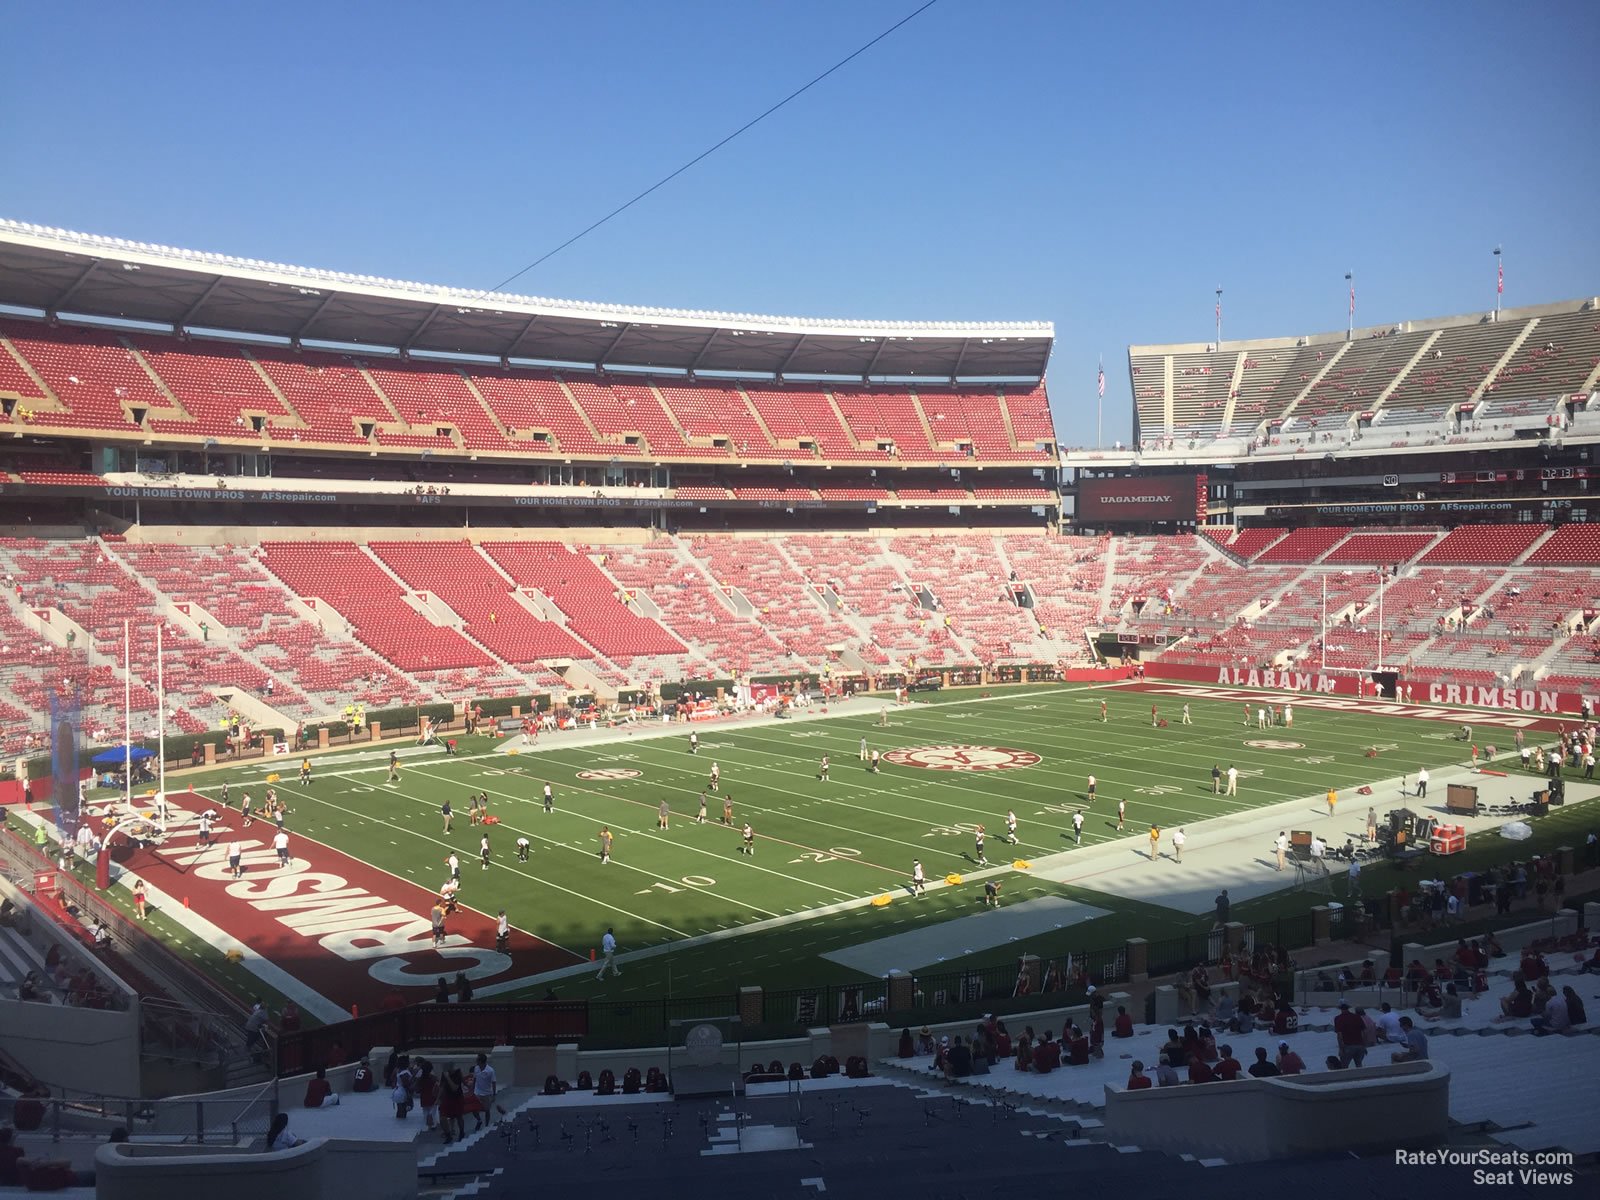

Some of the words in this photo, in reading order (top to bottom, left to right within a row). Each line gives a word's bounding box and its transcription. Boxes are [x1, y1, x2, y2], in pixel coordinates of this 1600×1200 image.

[105, 487, 139, 496] YOUR
[142, 488, 211, 498] HOMETOWN
[214, 490, 245, 499] PROS
[261, 491, 337, 502] AFSrepair.com
[421, 495, 441, 504] AFS
[514, 497, 540, 505] YOUR
[542, 498, 596, 506] HOMETOWN
[633, 499, 694, 508] AFSrepair.com
[1316, 506, 1342, 514] YOUR
[1343, 505, 1397, 514] HOMETOWN
[1399, 504, 1426, 512] PROS
[1440, 502, 1512, 512] AFSrepair.com
[1550, 500, 1572, 509] AFS
[1217, 667, 1330, 693] ALABAMA
[1429, 683, 1558, 713] CRIMSON
[1043, 802, 1091, 814] 40
[800, 847, 862, 863] 20
[650, 875, 718, 894] 10
[154, 838, 514, 987] CRIMSON
[355, 1068, 366, 1080] 15
